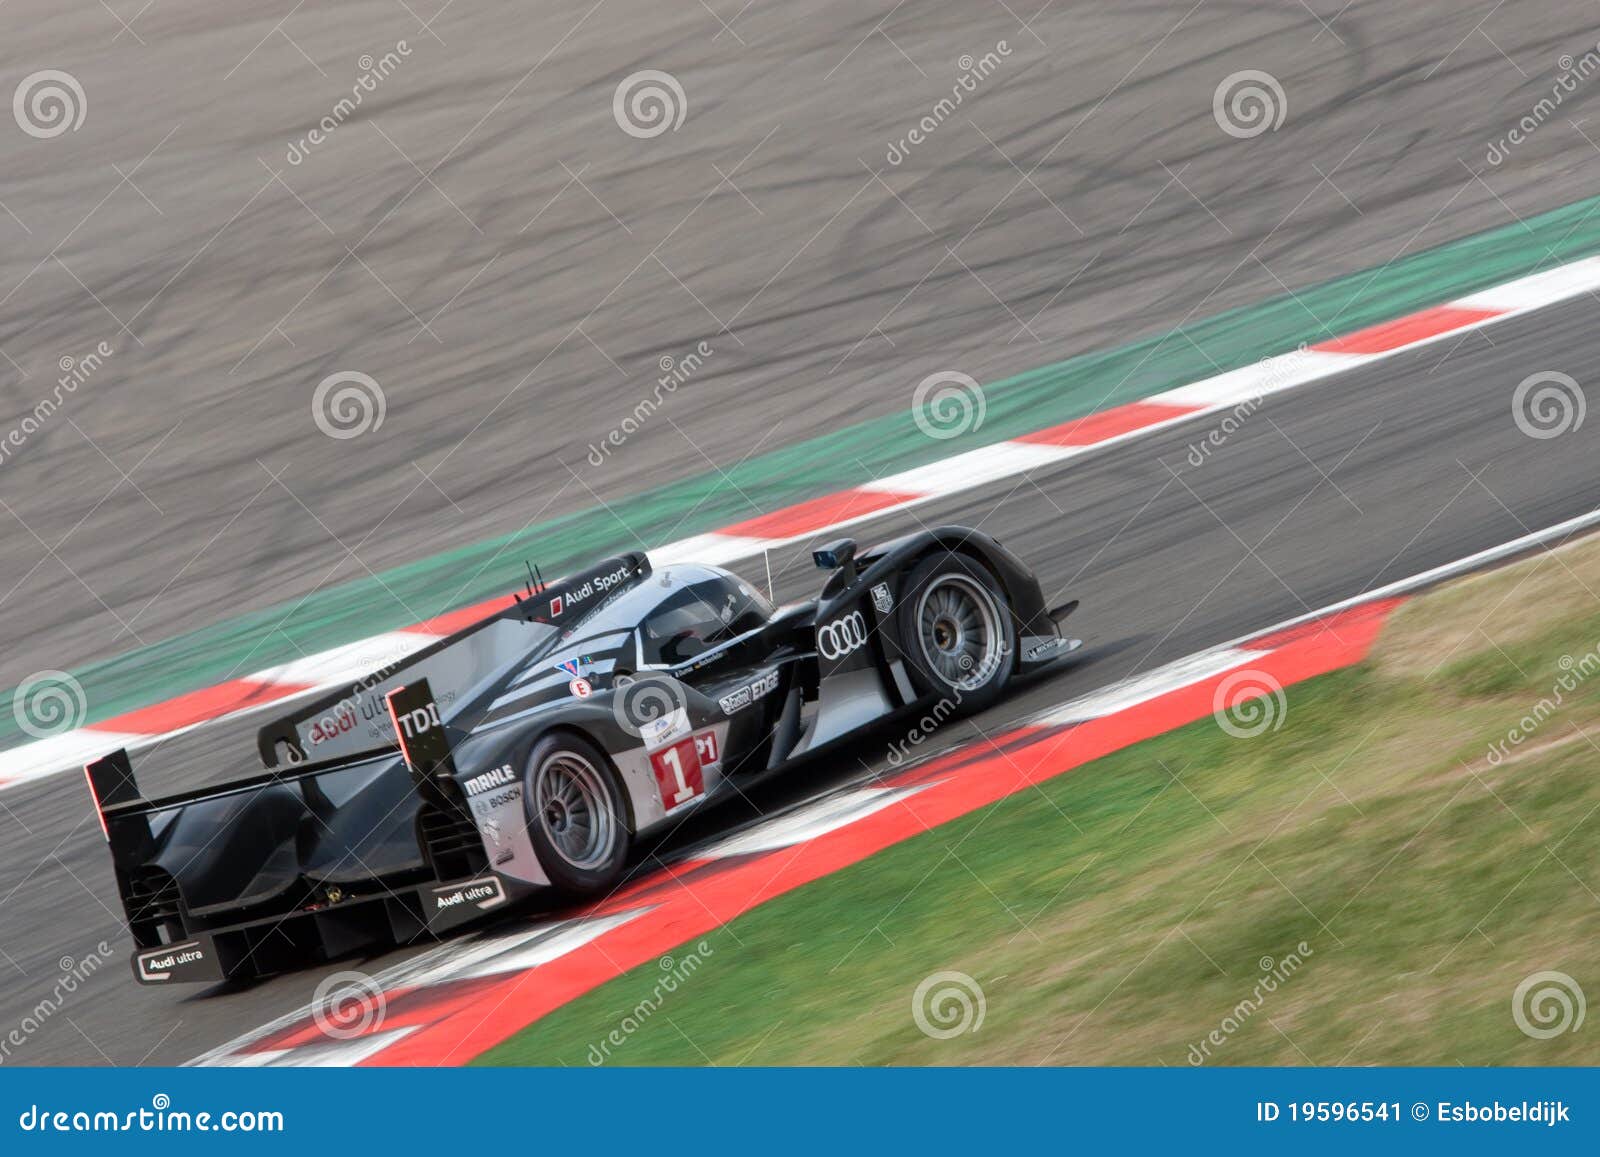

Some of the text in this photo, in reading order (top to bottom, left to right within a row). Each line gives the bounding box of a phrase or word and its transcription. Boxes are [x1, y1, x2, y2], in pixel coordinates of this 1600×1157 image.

[565, 566, 630, 606] Audi Sport
[576, 682, 587, 696] E
[751, 670, 779, 701] EDGE
[312, 705, 358, 746] Audi
[397, 702, 441, 738] TDI
[695, 735, 717, 760] P1
[464, 764, 516, 797] MAHLE
[662, 746, 695, 804] 1
[489, 786, 521, 809] BOSCH
[437, 885, 494, 908] Audi ultra
[149, 950, 204, 970] Audi ultra
